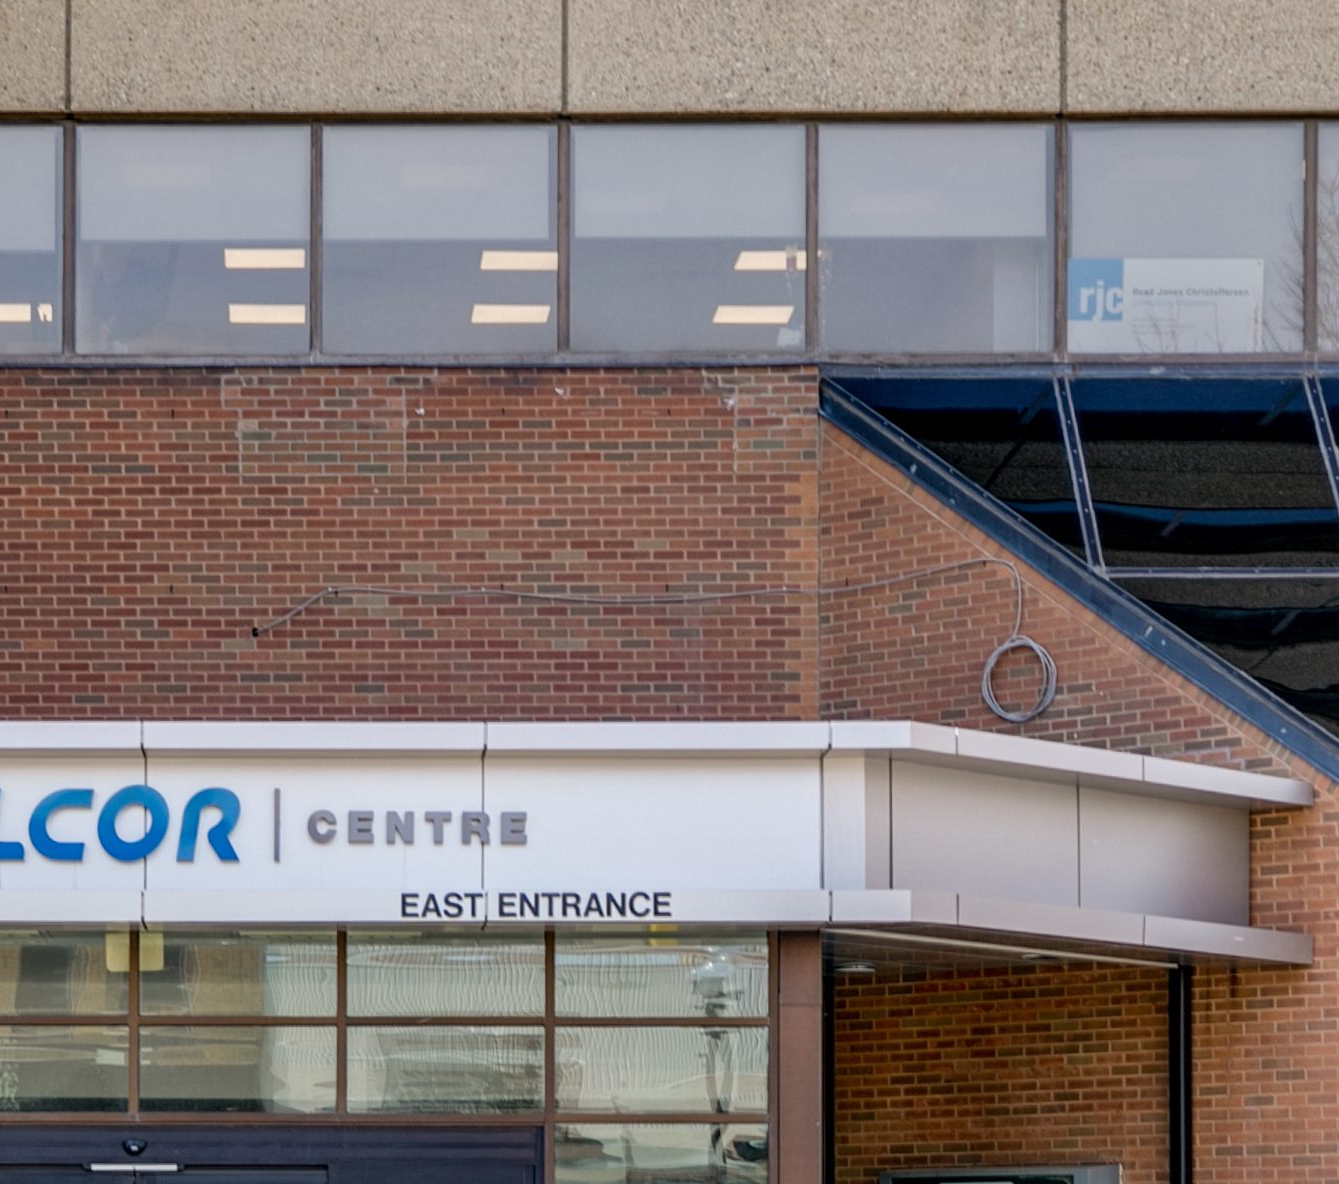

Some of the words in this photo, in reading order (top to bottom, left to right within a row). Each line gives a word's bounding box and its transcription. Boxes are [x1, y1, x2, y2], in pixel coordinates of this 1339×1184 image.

[1080, 279, 1124, 322] rjc
[305, 809, 529, 847] CENTRE
[399, 891, 484, 920] EAST
[498, 891, 672, 919] ENTRANCE
